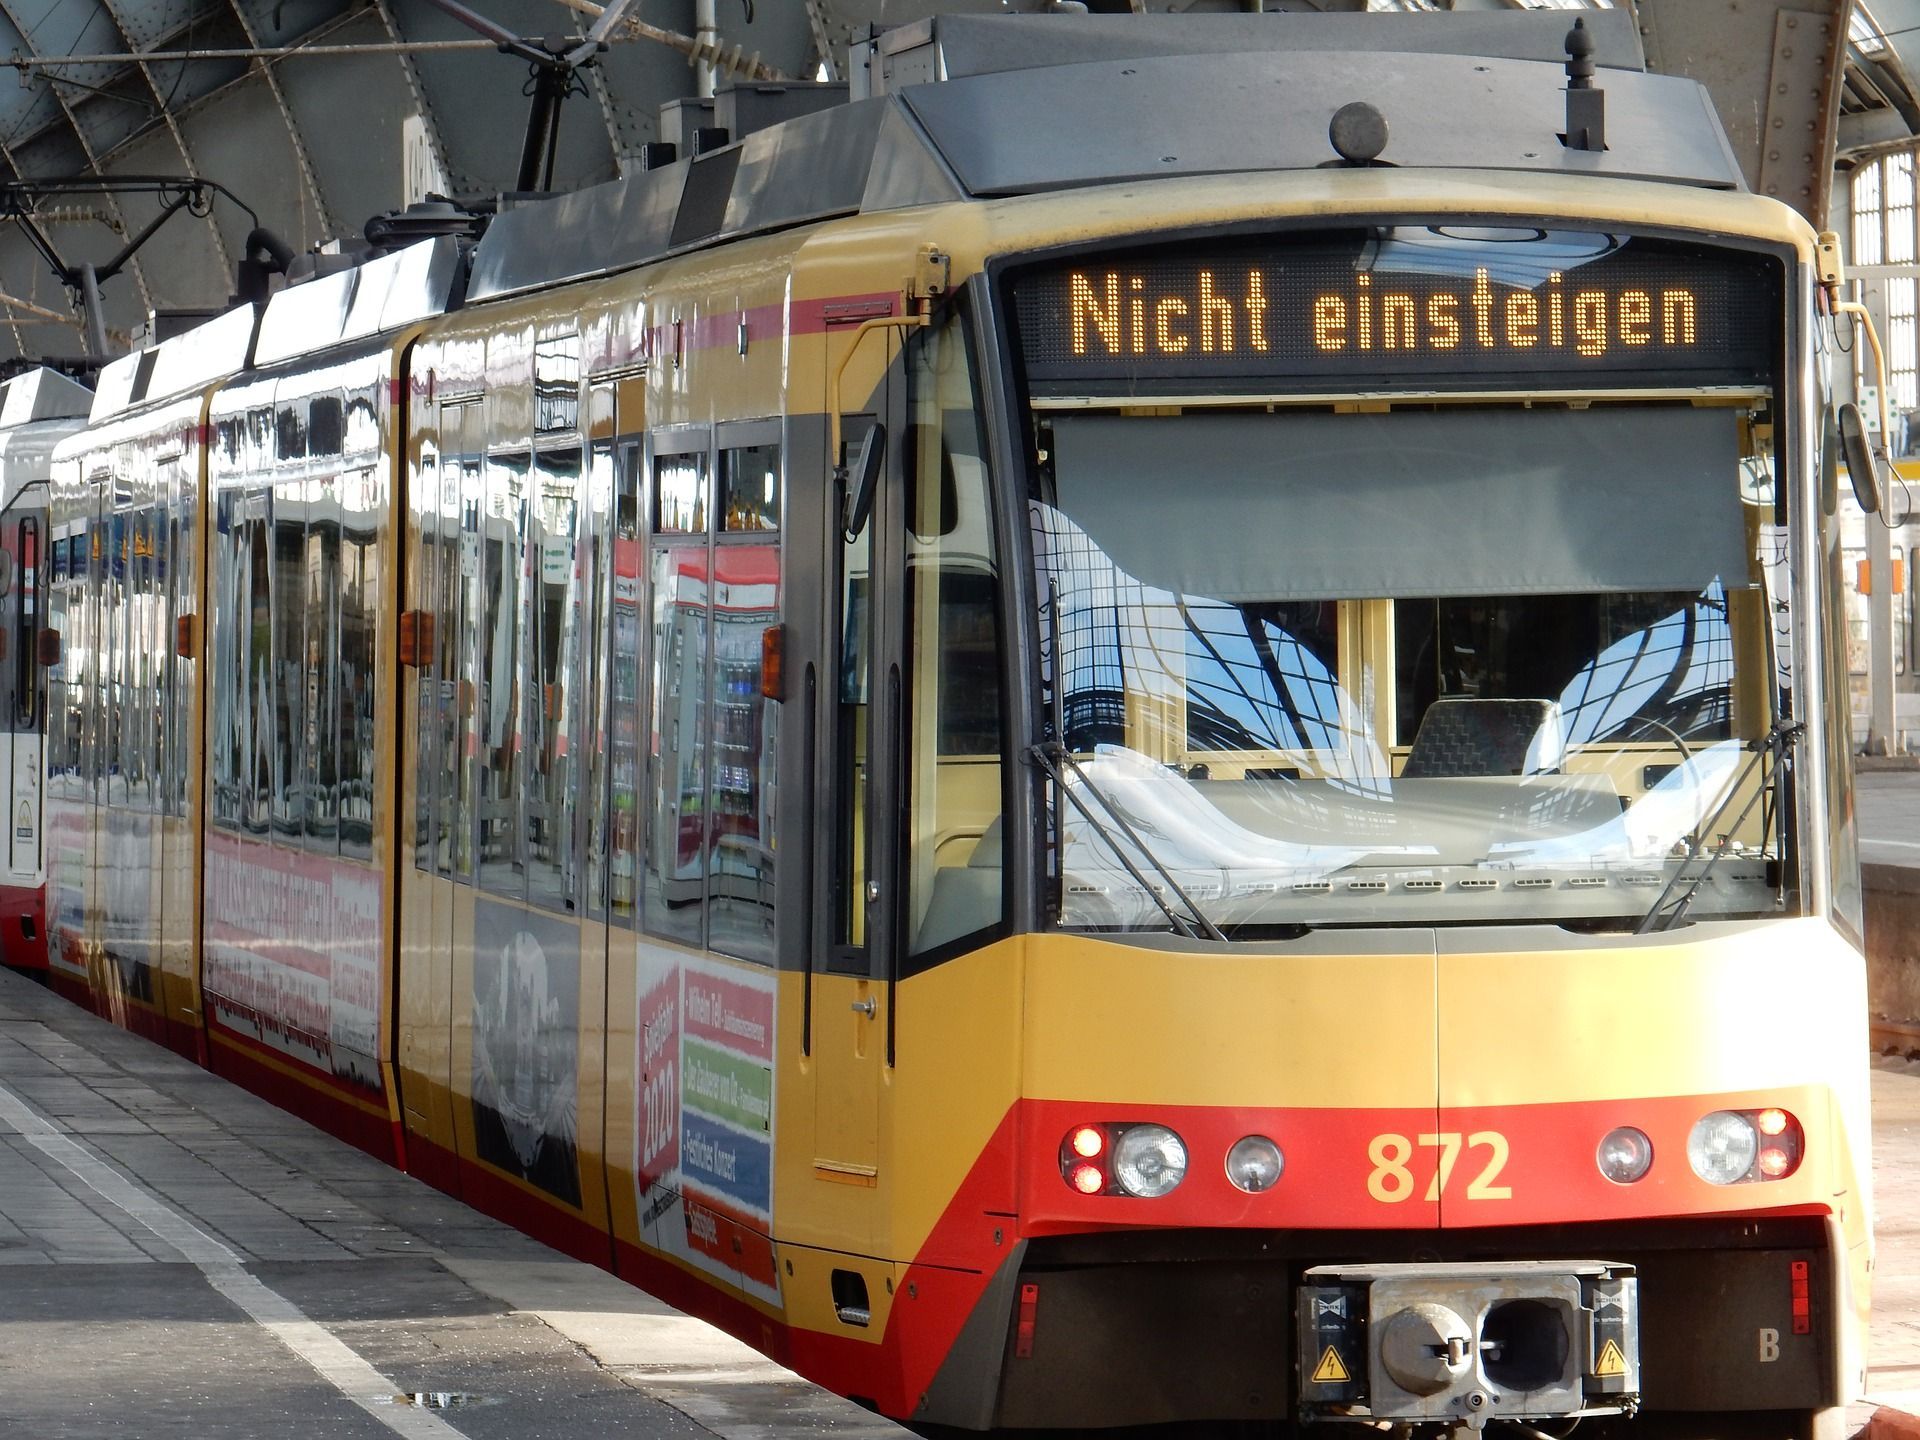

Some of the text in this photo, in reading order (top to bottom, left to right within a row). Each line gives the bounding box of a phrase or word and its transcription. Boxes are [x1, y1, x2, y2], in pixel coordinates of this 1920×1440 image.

[1071, 266, 1696, 357] Nicht einsteigen
[643, 1059, 675, 1168] 2020
[1367, 1131, 1513, 1203] 872
[1759, 1327, 1780, 1363] B
